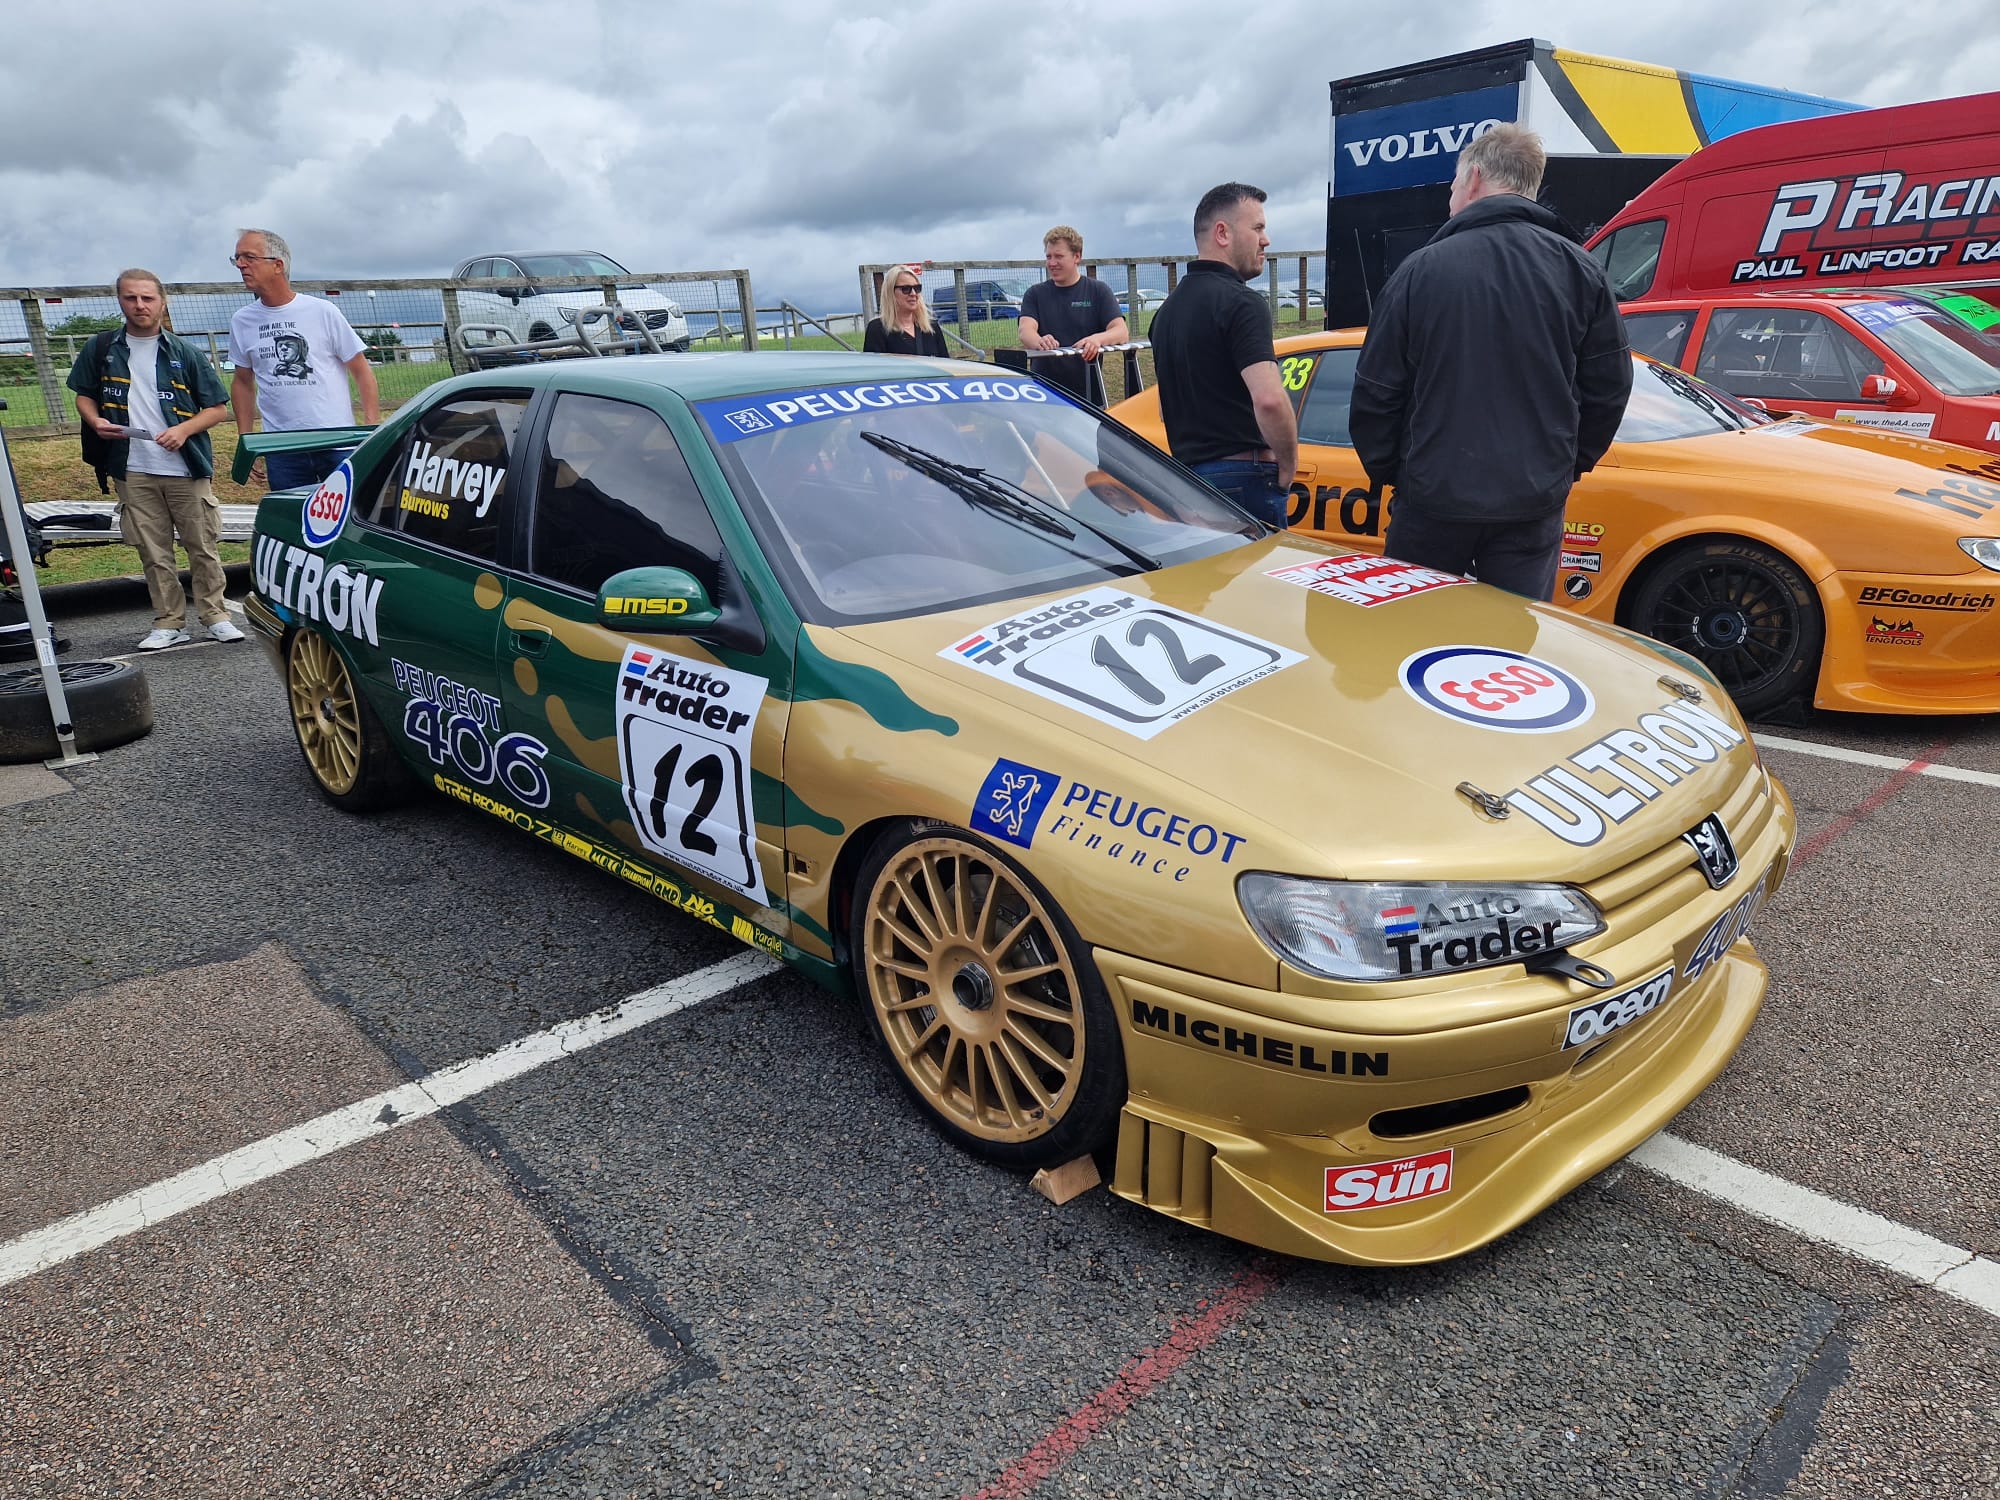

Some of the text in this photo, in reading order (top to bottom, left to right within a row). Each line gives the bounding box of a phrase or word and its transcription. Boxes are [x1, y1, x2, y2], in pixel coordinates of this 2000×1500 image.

[1733, 257, 1804, 281] PAUL
[1819, 245, 1948, 273] LINFOOT
[766, 380, 1048, 424] PEUGEOT 406
[1281, 356, 1314, 391] 33
[1855, 418, 1931, 429] www.theAA.com
[400, 489, 450, 520] Burrows
[403, 440, 506, 519] Harvey
[1563, 521, 1605, 536] NEO
[1330, 567, 1458, 605] News
[1561, 555, 1599, 567] CHAMPION
[255, 534, 385, 648] ULTRON
[1859, 586, 1996, 608] BFGoodrich
[972, 596, 1137, 667] Trader
[991, 599, 1090, 642] Auto
[647, 657, 731, 698] Auto
[1091, 618, 1227, 706] 12
[391, 657, 502, 732] PEUGEOT
[621, 676, 751, 735] Trader
[1170, 663, 1283, 721] www.autotrader.co.uk
[403, 697, 551, 809] 406
[1503, 698, 1746, 848] ULTRON
[650, 743, 724, 857] 12
[1062, 781, 1248, 864] PEUGEOT
[1047, 814, 1191, 882] Finance
[1420, 895, 1521, 929] Auto
[1386, 918, 1562, 975] Trader
[1568, 973, 1673, 1045] ocean
[1131, 999, 1389, 1077] MICHELIN
[1327, 1162, 1449, 1207] Sun
[1391, 1159, 1418, 1173] THE
